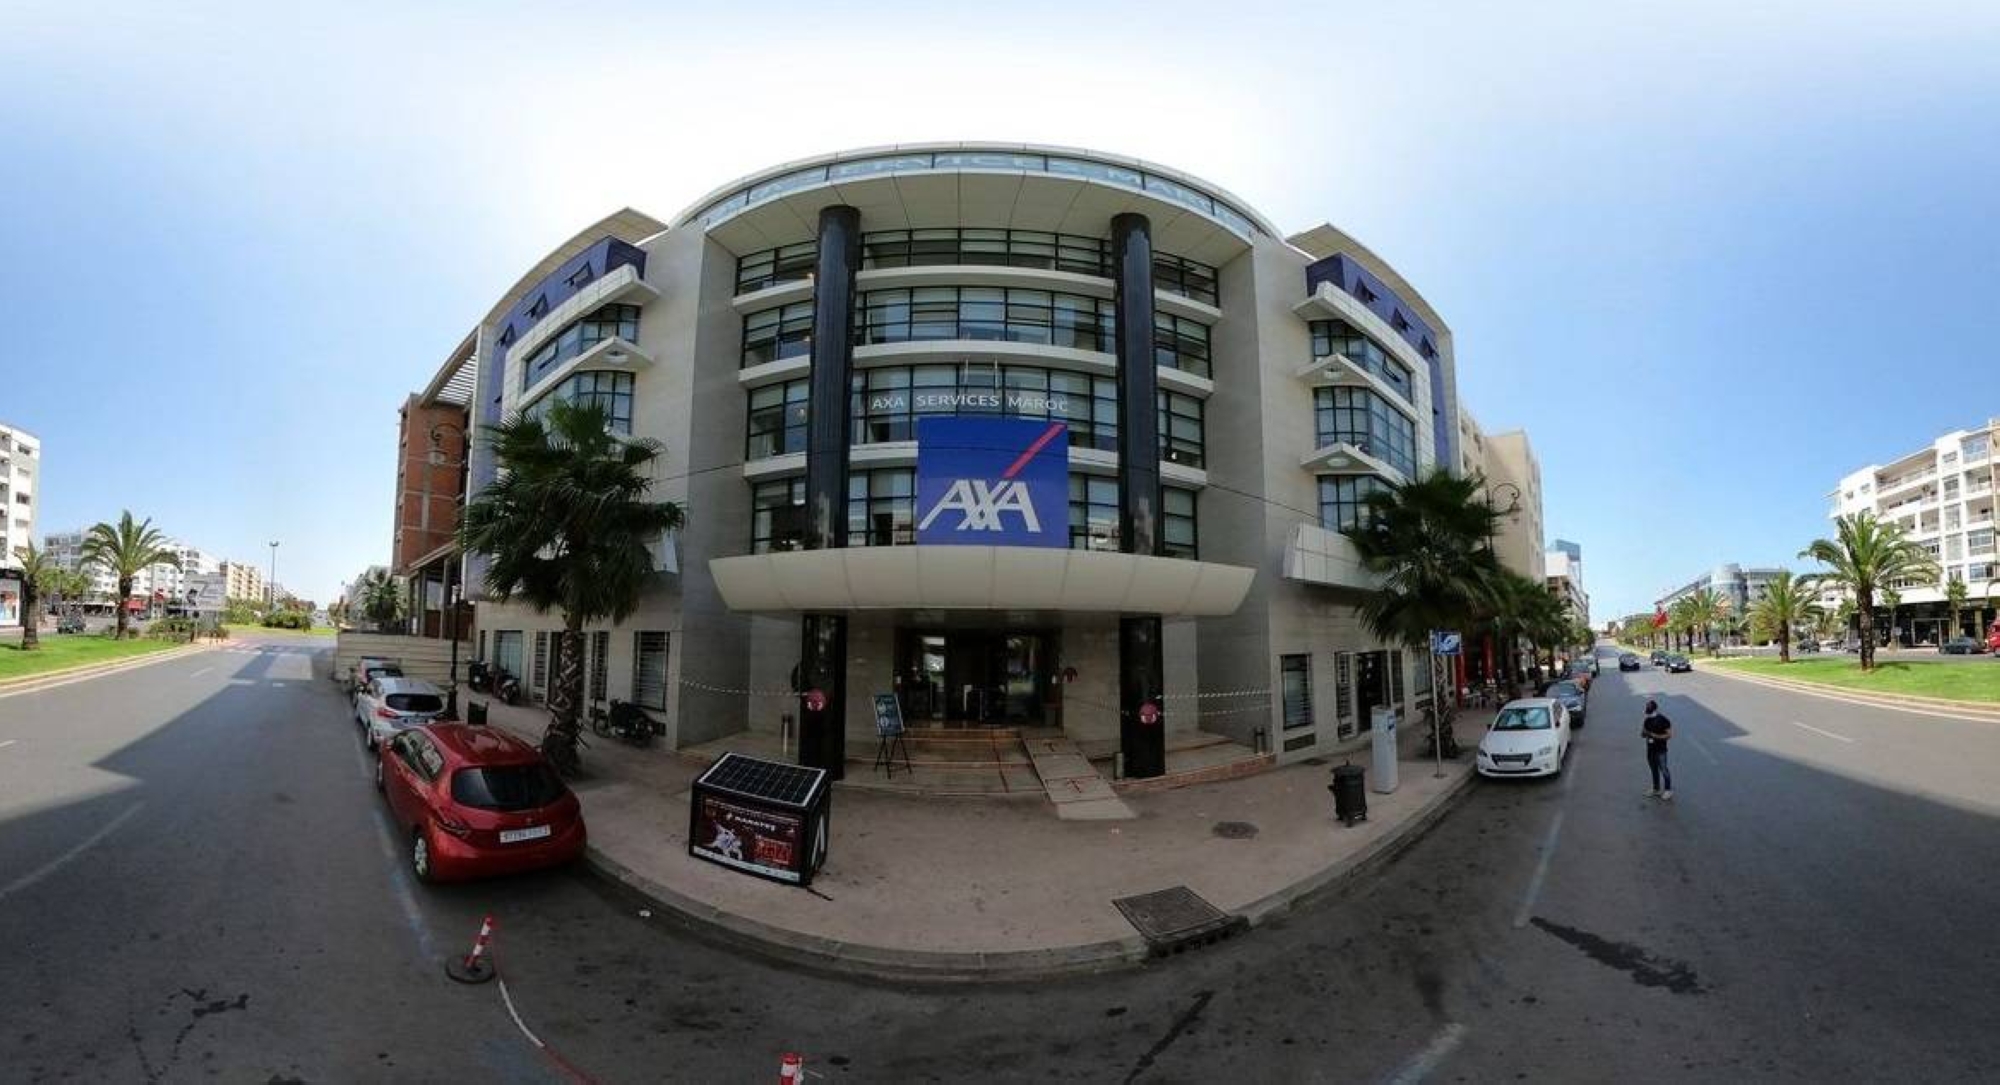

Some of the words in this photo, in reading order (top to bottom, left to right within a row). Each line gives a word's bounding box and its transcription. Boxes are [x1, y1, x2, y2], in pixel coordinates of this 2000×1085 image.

[871, 396, 904, 410] AXA
[916, 394, 1000, 407] SERVICES
[1008, 396, 1069, 412] MAROC
[918, 479, 1041, 533] AXA
